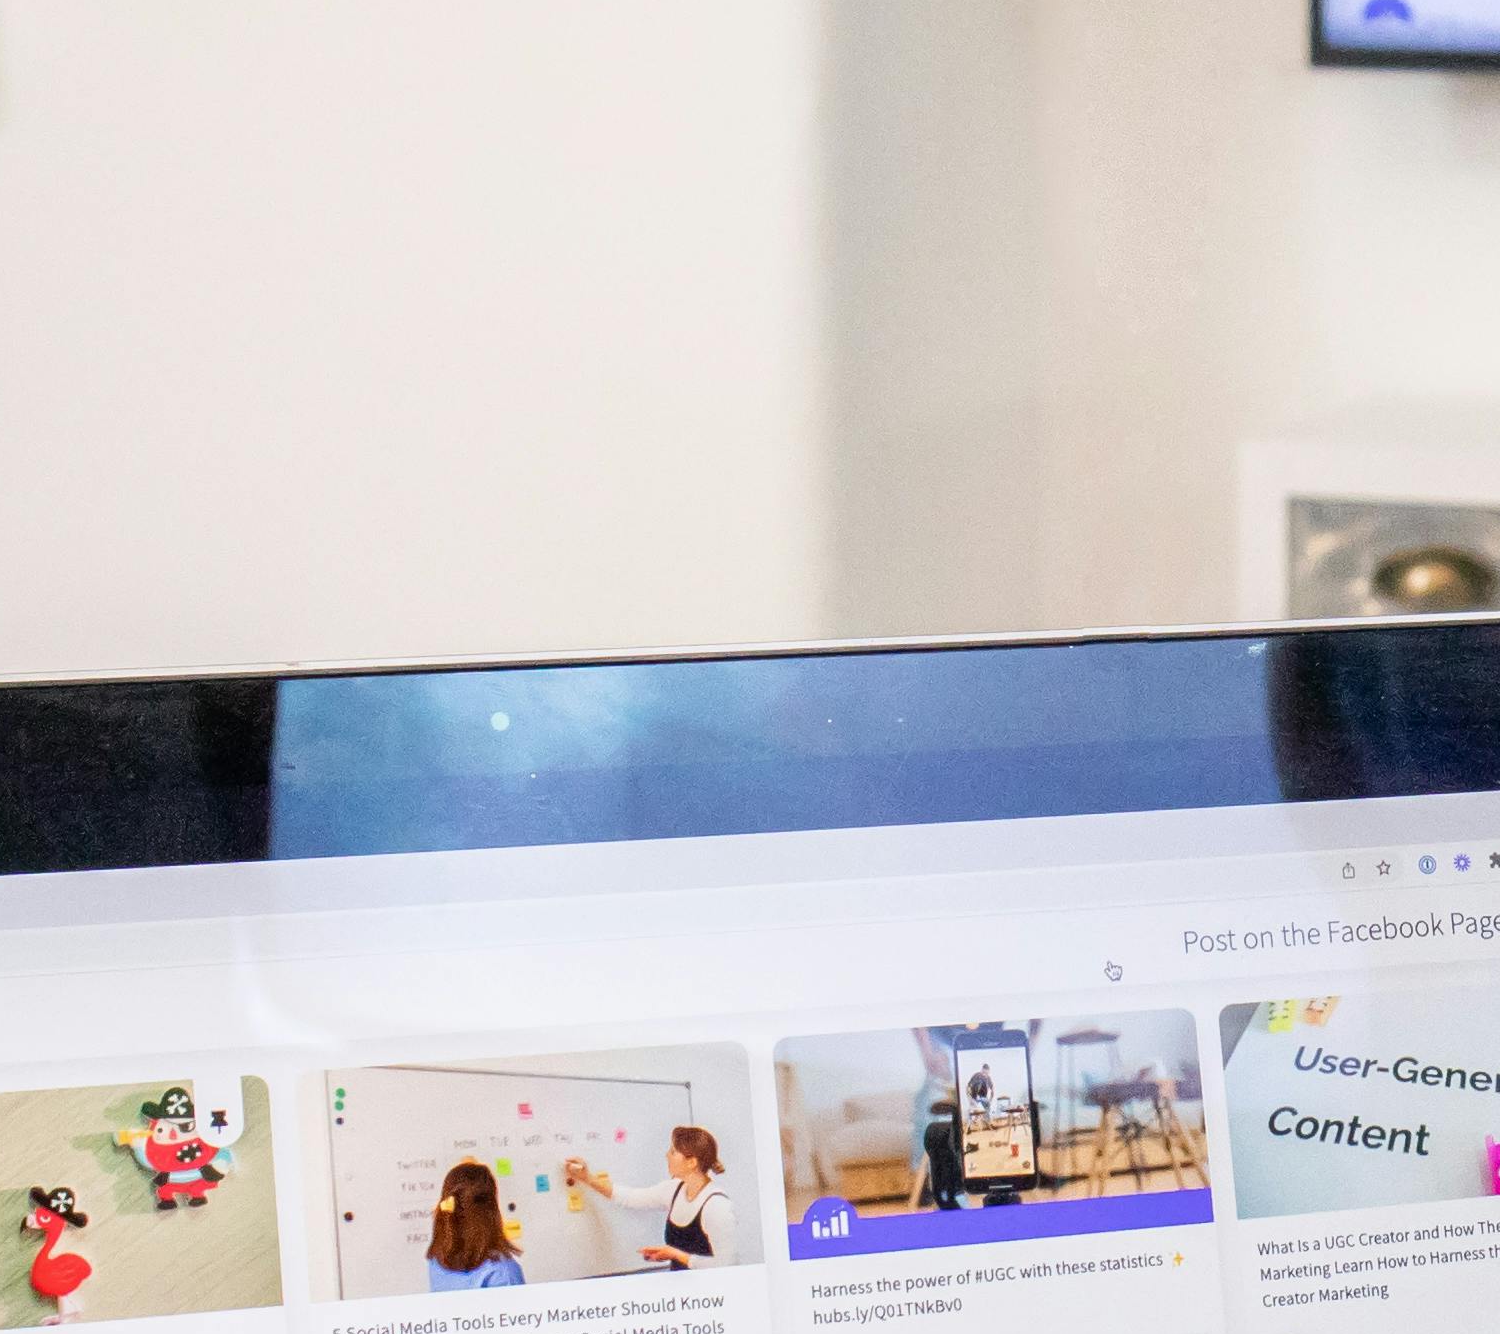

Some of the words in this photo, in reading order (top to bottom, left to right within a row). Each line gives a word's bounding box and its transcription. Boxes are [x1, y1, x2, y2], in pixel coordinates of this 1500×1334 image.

[1184, 930, 1237, 954] Post
[1243, 930, 1274, 950] on
[1281, 921, 1321, 947] the
[1328, 912, 1444, 943] Facebook
[1268, 1105, 1431, 1156] Content
[811, 1282, 873, 1299] Harness
[876, 1277, 901, 1293] the
[905, 1274, 953, 1294] power
[956, 1269, 971, 1285] of
[975, 1266, 1016, 1284] #UGC
[1019, 1262, 1052, 1279] with
[1055, 1260, 1096, 1276] these
[1099, 1253, 1164, 1272] statistics
[451, 1314, 495, 1331] Tools
[499, 1313, 543, 1329] Every
[547, 1305, 617, 1323] Marketer
[621, 1297, 677, 1317] Should
[680, 1295, 724, 1311] Know
